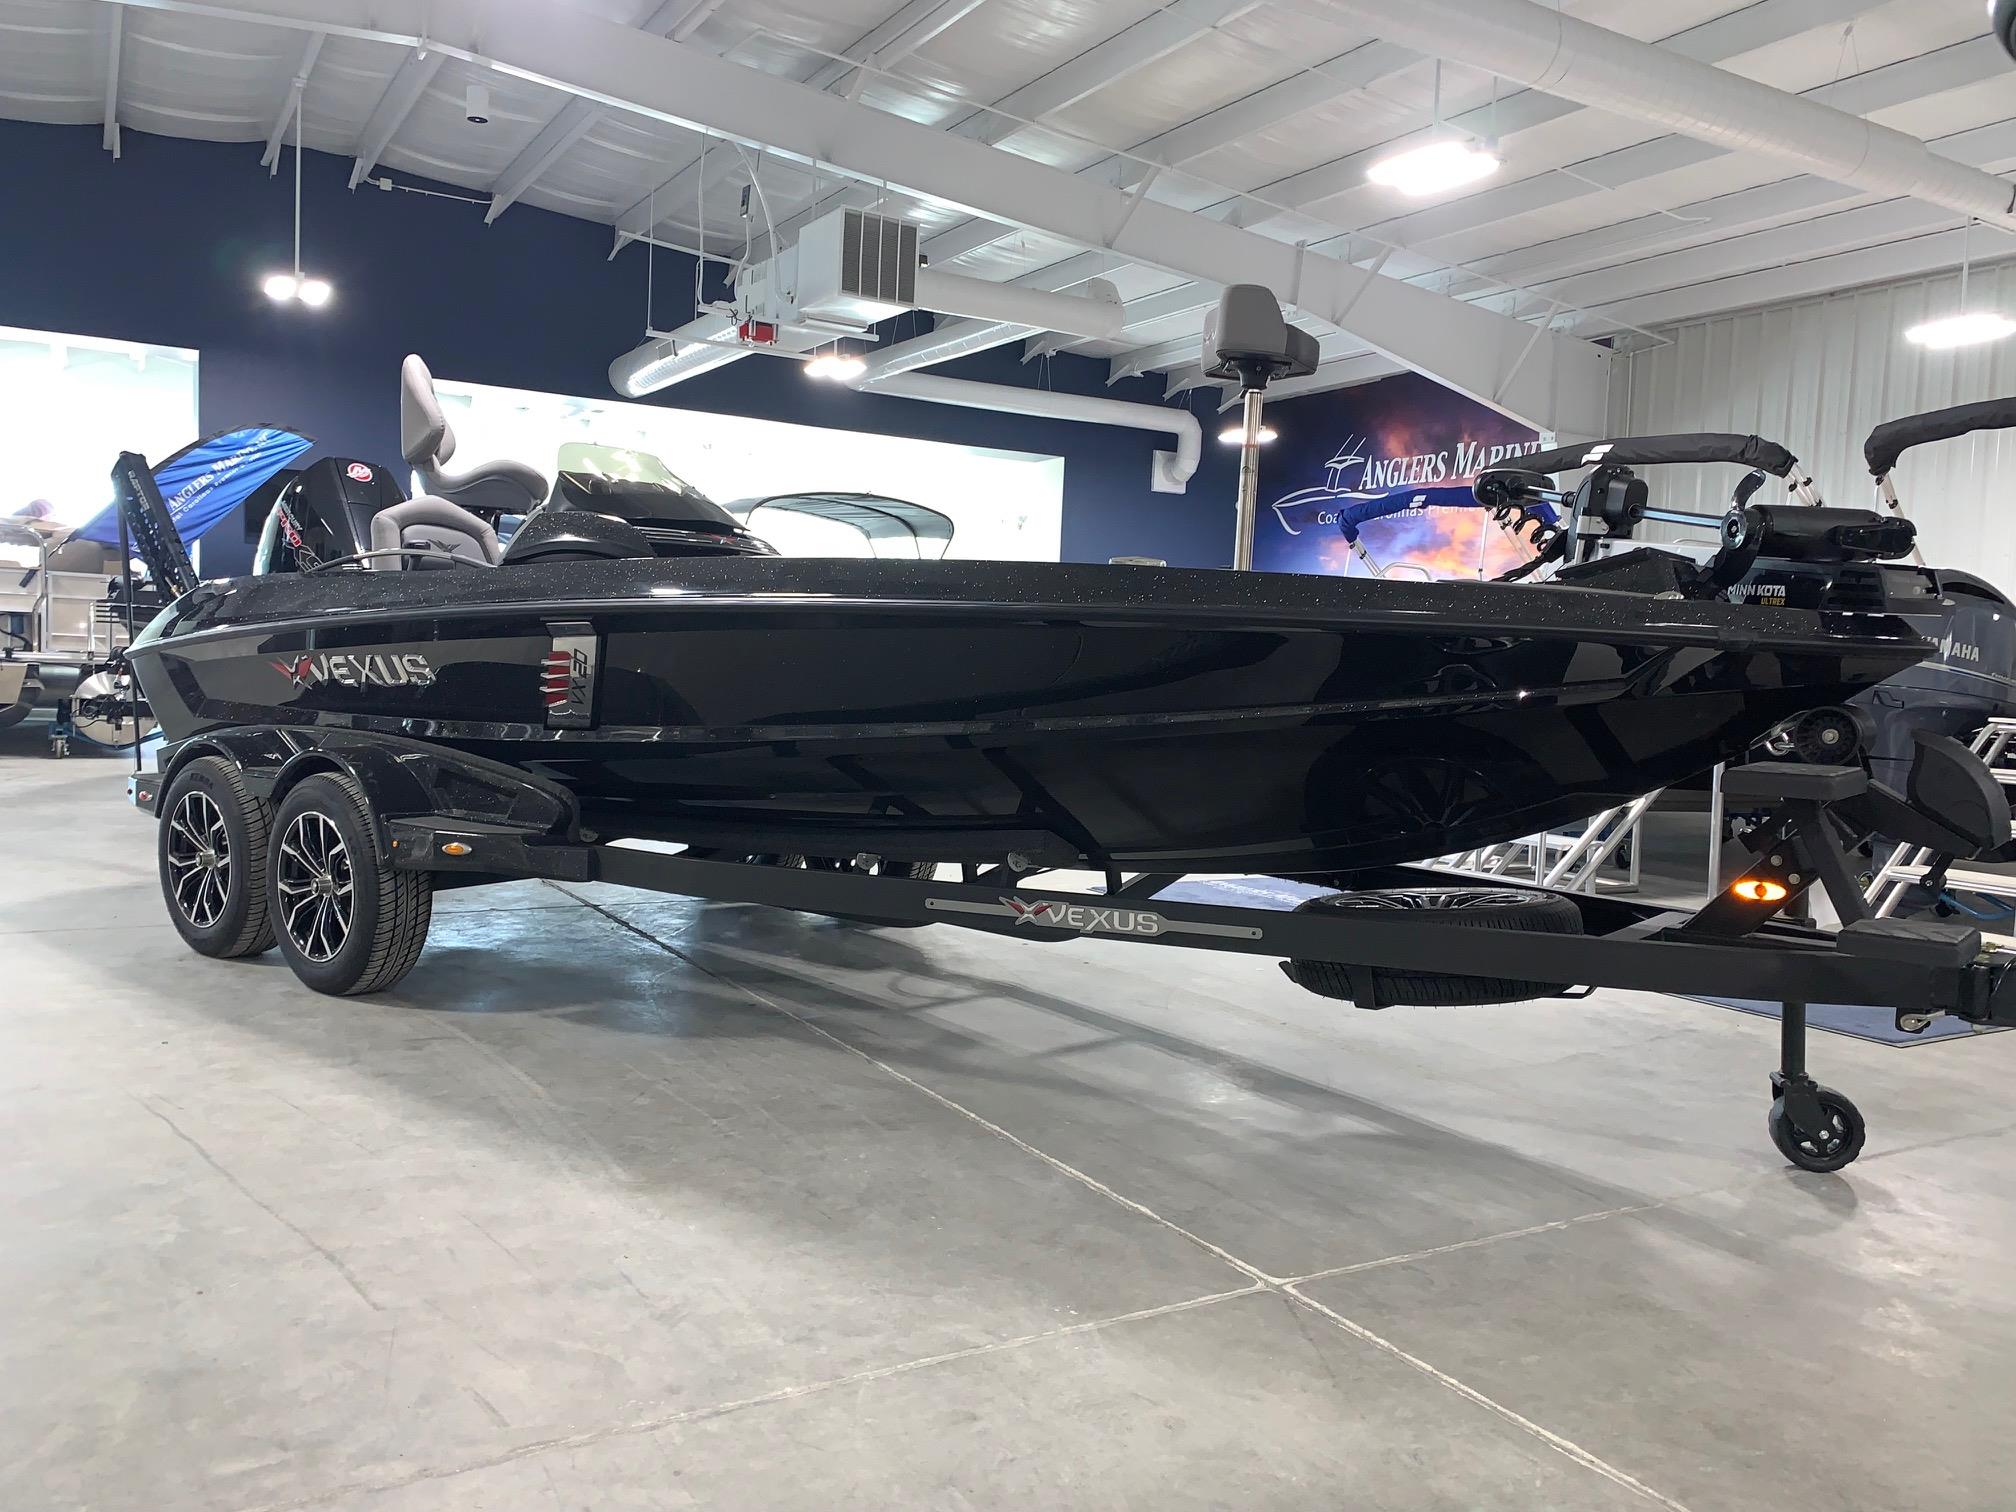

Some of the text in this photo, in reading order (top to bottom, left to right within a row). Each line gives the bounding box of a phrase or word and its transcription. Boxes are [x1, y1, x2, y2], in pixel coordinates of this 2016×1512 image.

[1359, 451, 1448, 490] ANGLERS
[168, 474, 215, 511] ANGLERS
[1727, 584, 1786, 597] MINN KOTA
[1760, 597, 1786, 606] ULTREX
[310, 653, 436, 688] VEXUS
[1047, 903, 1159, 933] VEXUS
